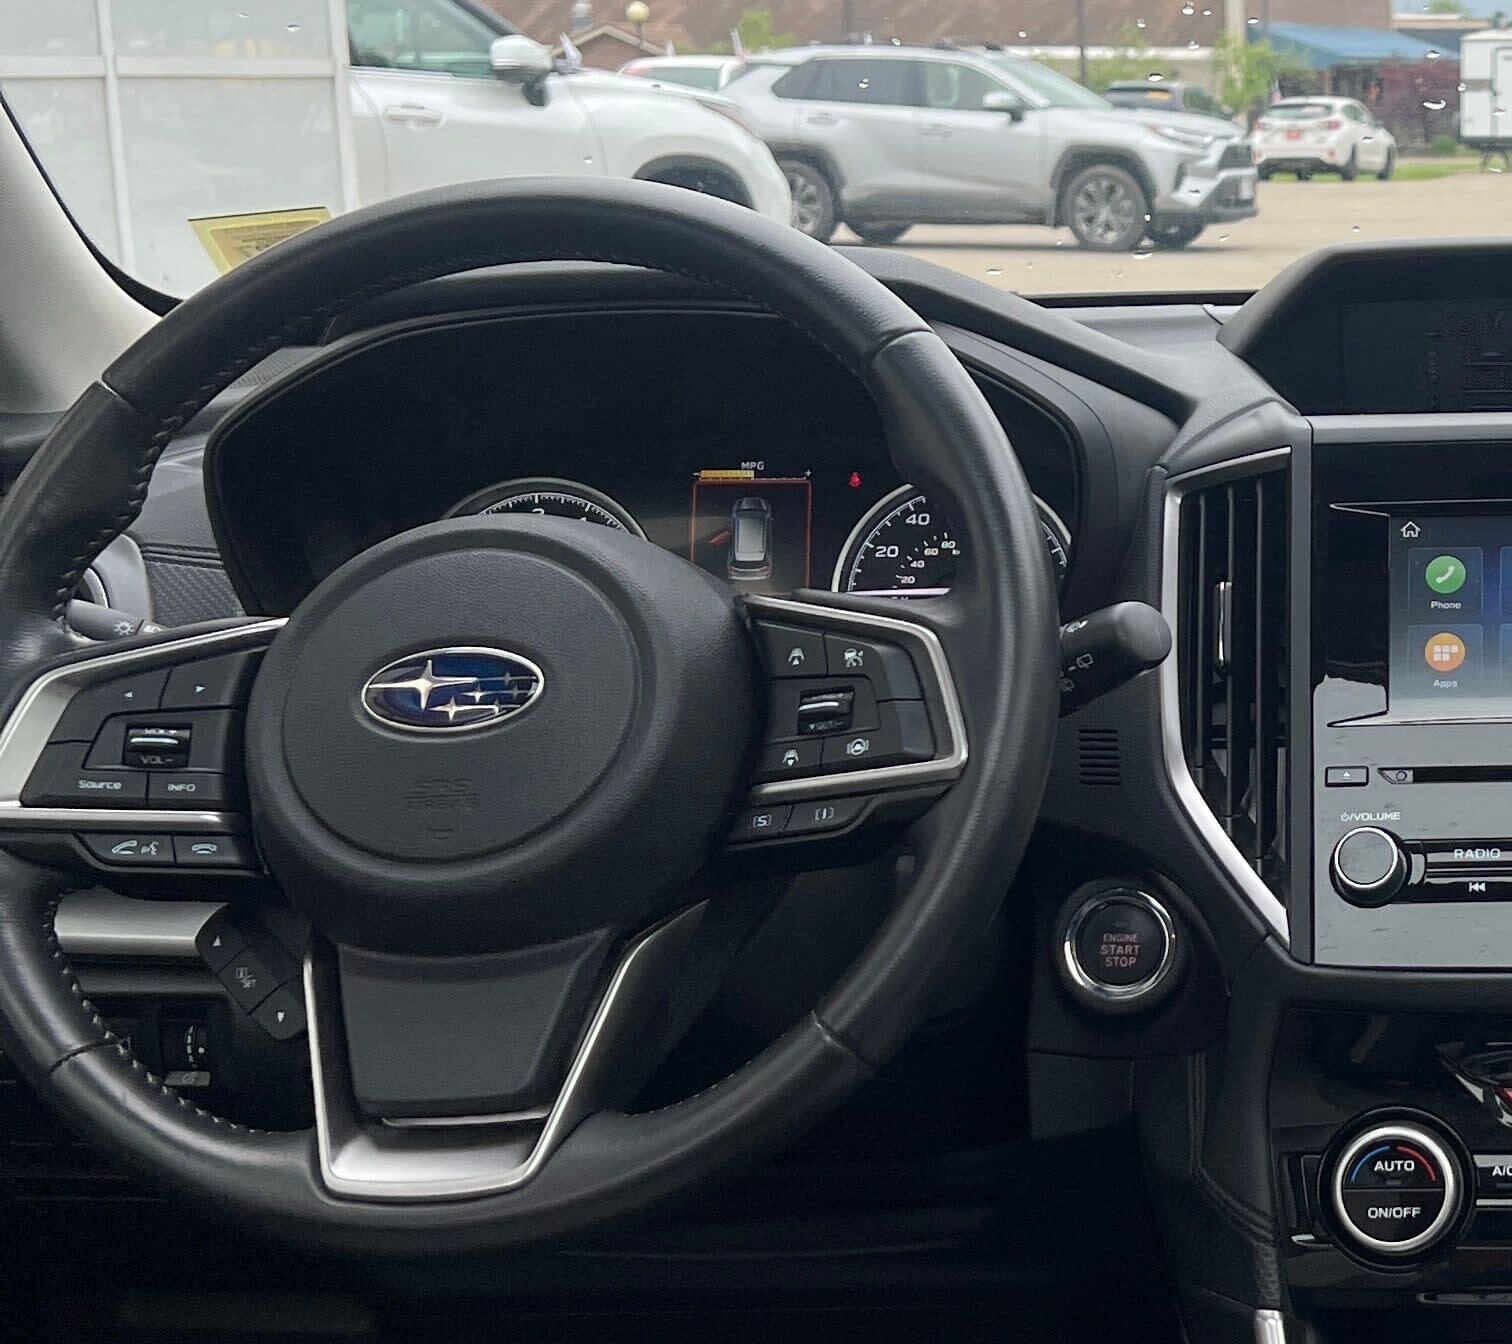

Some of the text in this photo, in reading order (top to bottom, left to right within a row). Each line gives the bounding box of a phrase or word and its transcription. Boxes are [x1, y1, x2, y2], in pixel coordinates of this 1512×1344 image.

[741, 461, 764, 470] MPG
[905, 513, 930, 525] 40
[875, 546, 899, 558] 20
[1430, 600, 1462, 610] Phone
[1433, 679, 1458, 688] Apps
[78, 779, 122, 790] Source
[167, 783, 196, 792] INFO
[1454, 848, 1500, 860] RADIO
[1101, 944, 1140, 955] START
[1105, 956, 1137, 967] STOP
[1374, 1160, 1415, 1172] AUTO
[1367, 1207, 1421, 1219] ON/OFF
